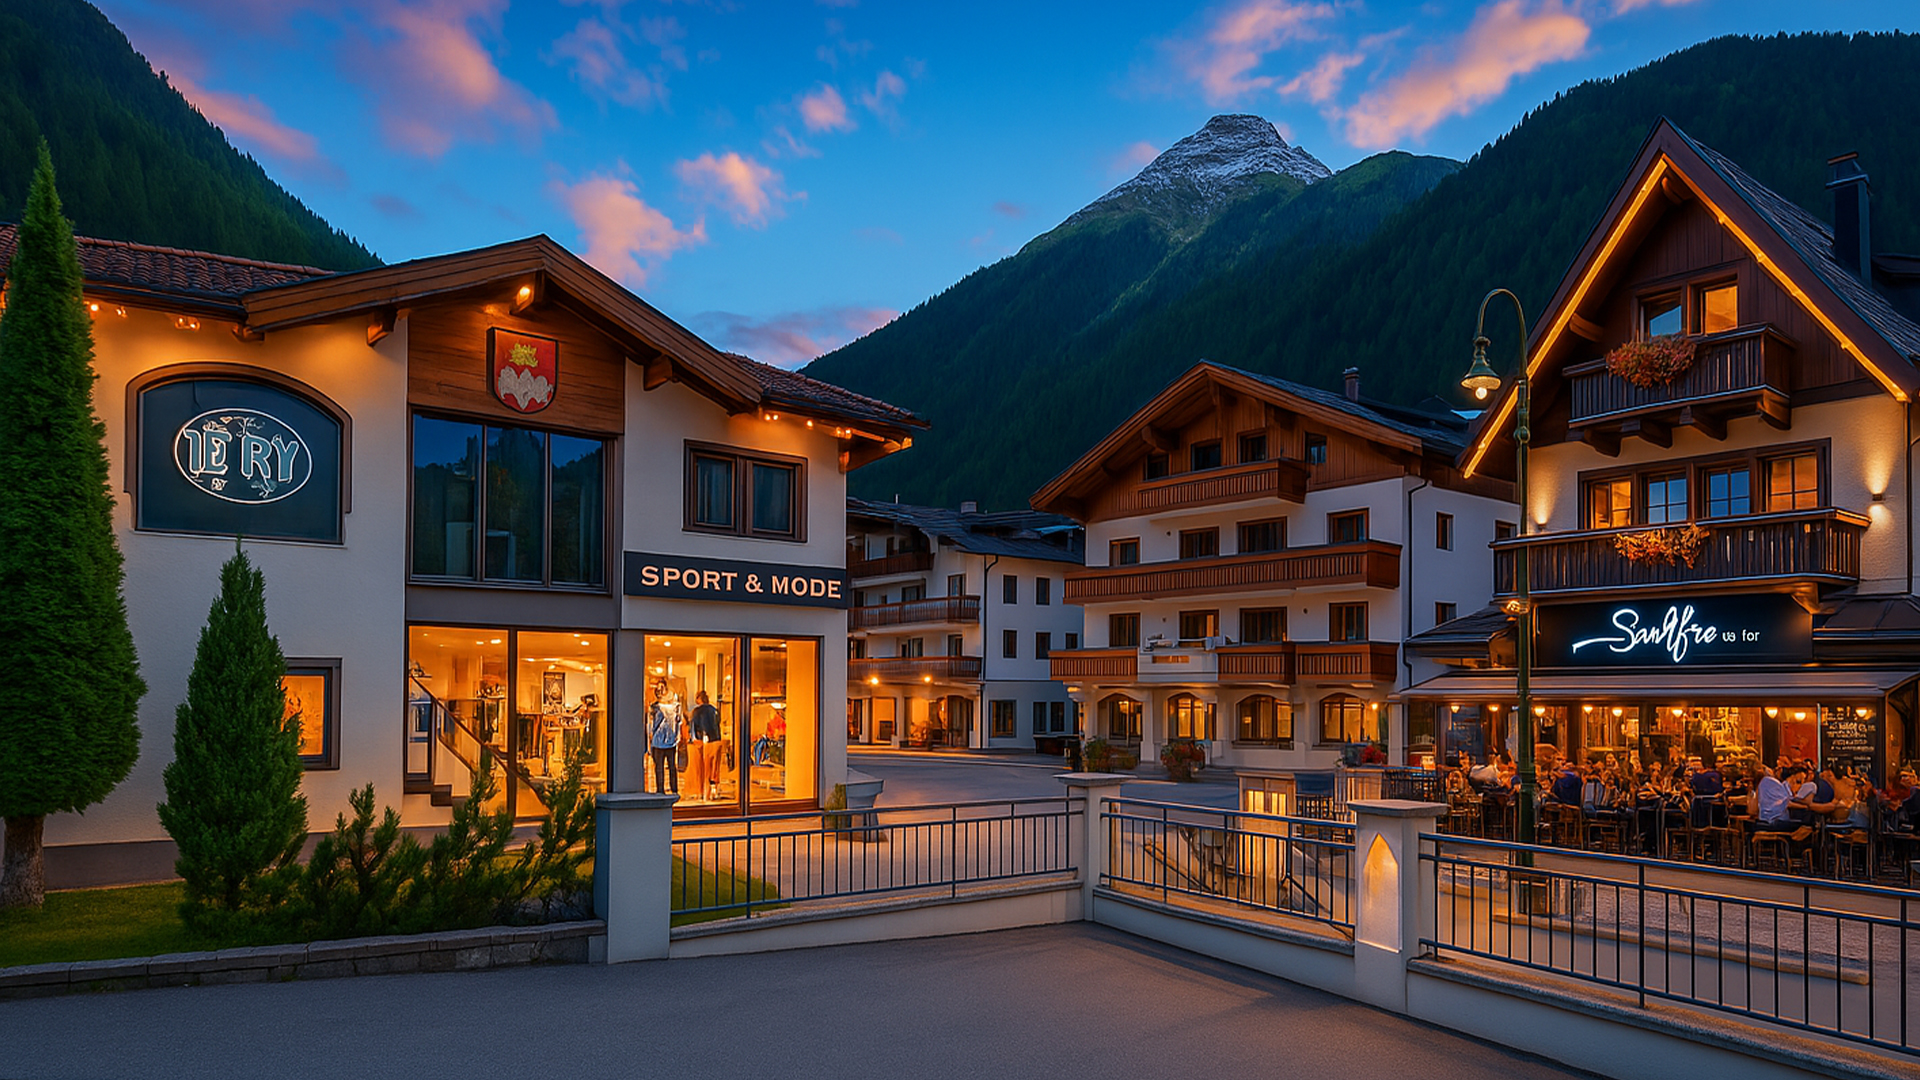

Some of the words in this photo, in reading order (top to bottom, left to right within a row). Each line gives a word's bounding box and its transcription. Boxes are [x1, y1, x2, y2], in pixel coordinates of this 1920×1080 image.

[641, 565, 738, 591] SPORT
[744, 573, 764, 593] &
[771, 575, 842, 599] MODE
[1741, 629, 1760, 642] for
